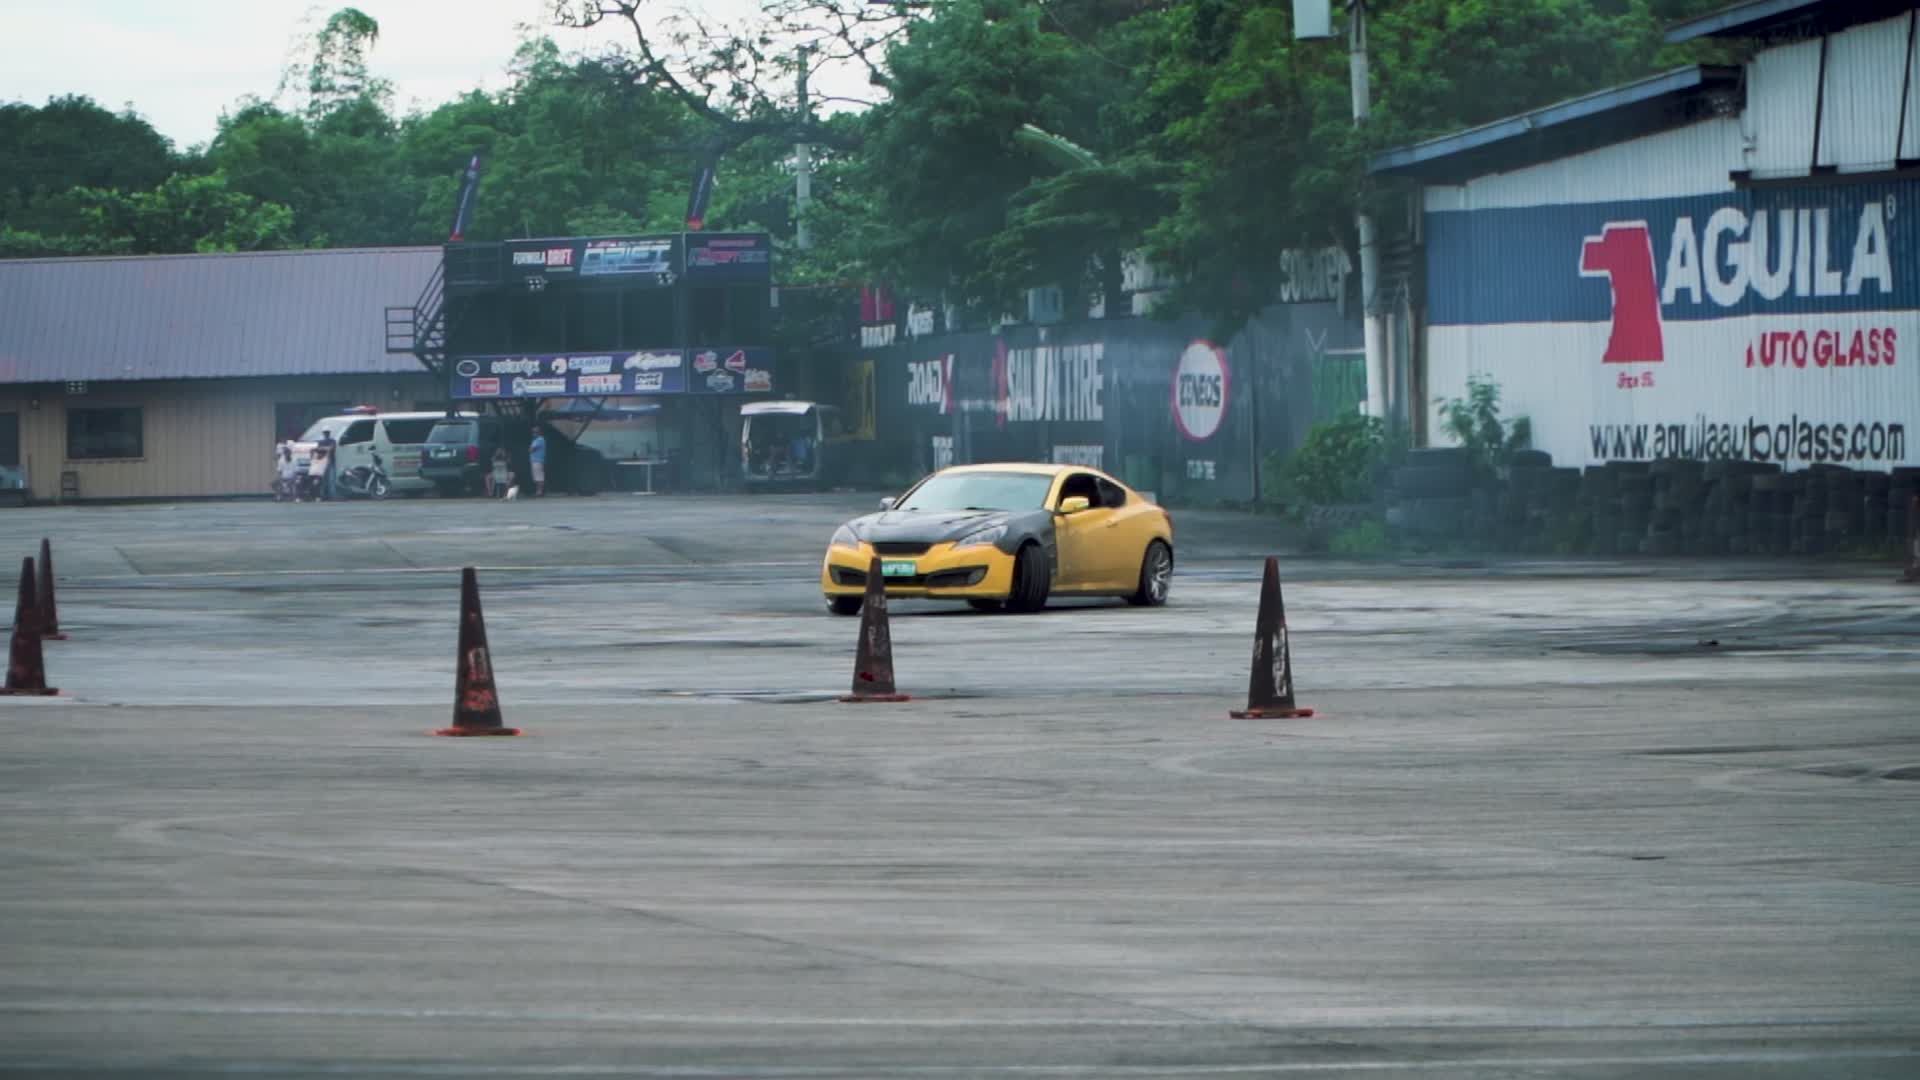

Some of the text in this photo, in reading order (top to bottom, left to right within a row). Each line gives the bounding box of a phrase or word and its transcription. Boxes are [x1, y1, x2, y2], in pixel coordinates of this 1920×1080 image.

[1661, 201, 1893, 307] AGUILA
[1062, 342, 1104, 421] TIRE
[1813, 327, 1897, 368] GLASS
